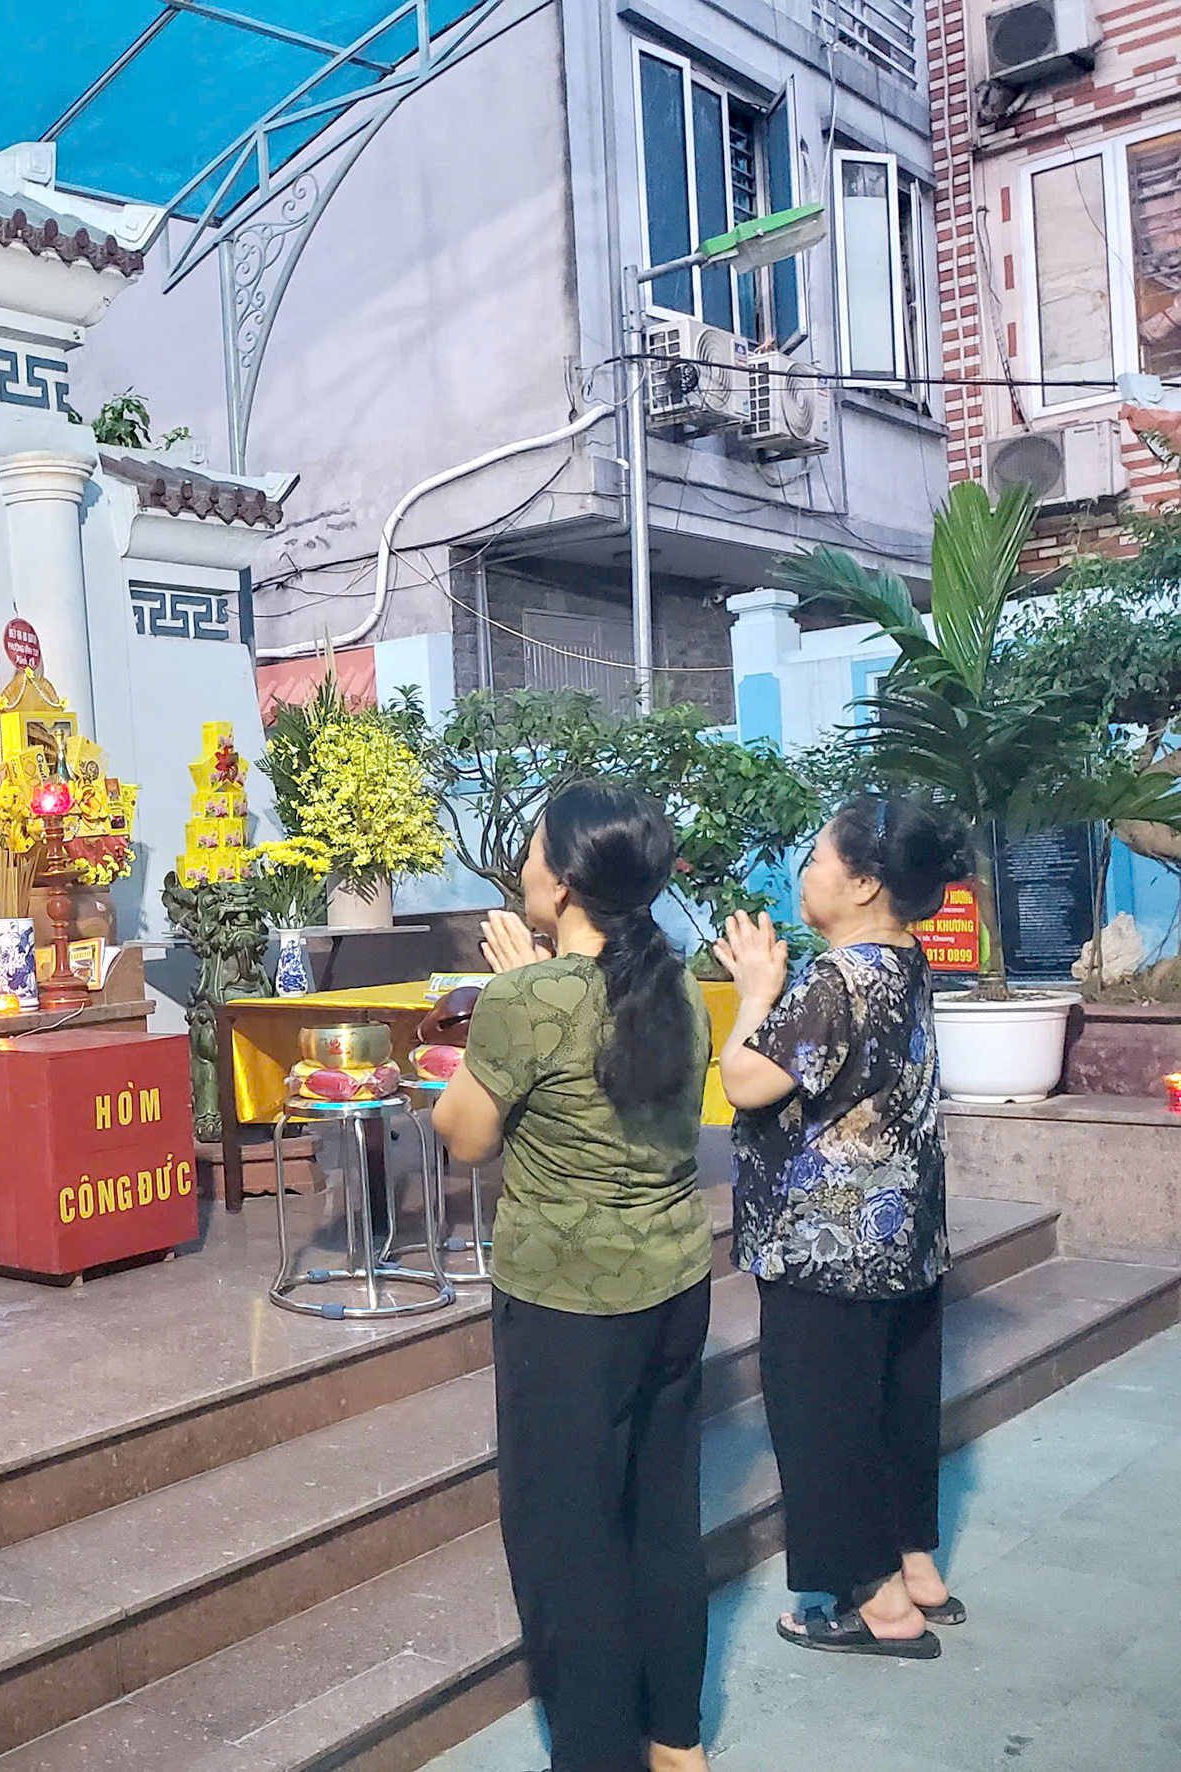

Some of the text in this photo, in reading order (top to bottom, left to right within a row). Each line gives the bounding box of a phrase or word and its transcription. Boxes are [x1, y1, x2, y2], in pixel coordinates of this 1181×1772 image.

[937, 919, 974, 932] KHƯƠNG
[947, 949, 973, 962] 0899
[94, 1081, 162, 1130] HÒM
[58, 1153, 193, 1224] CÔNG ĐỨC
